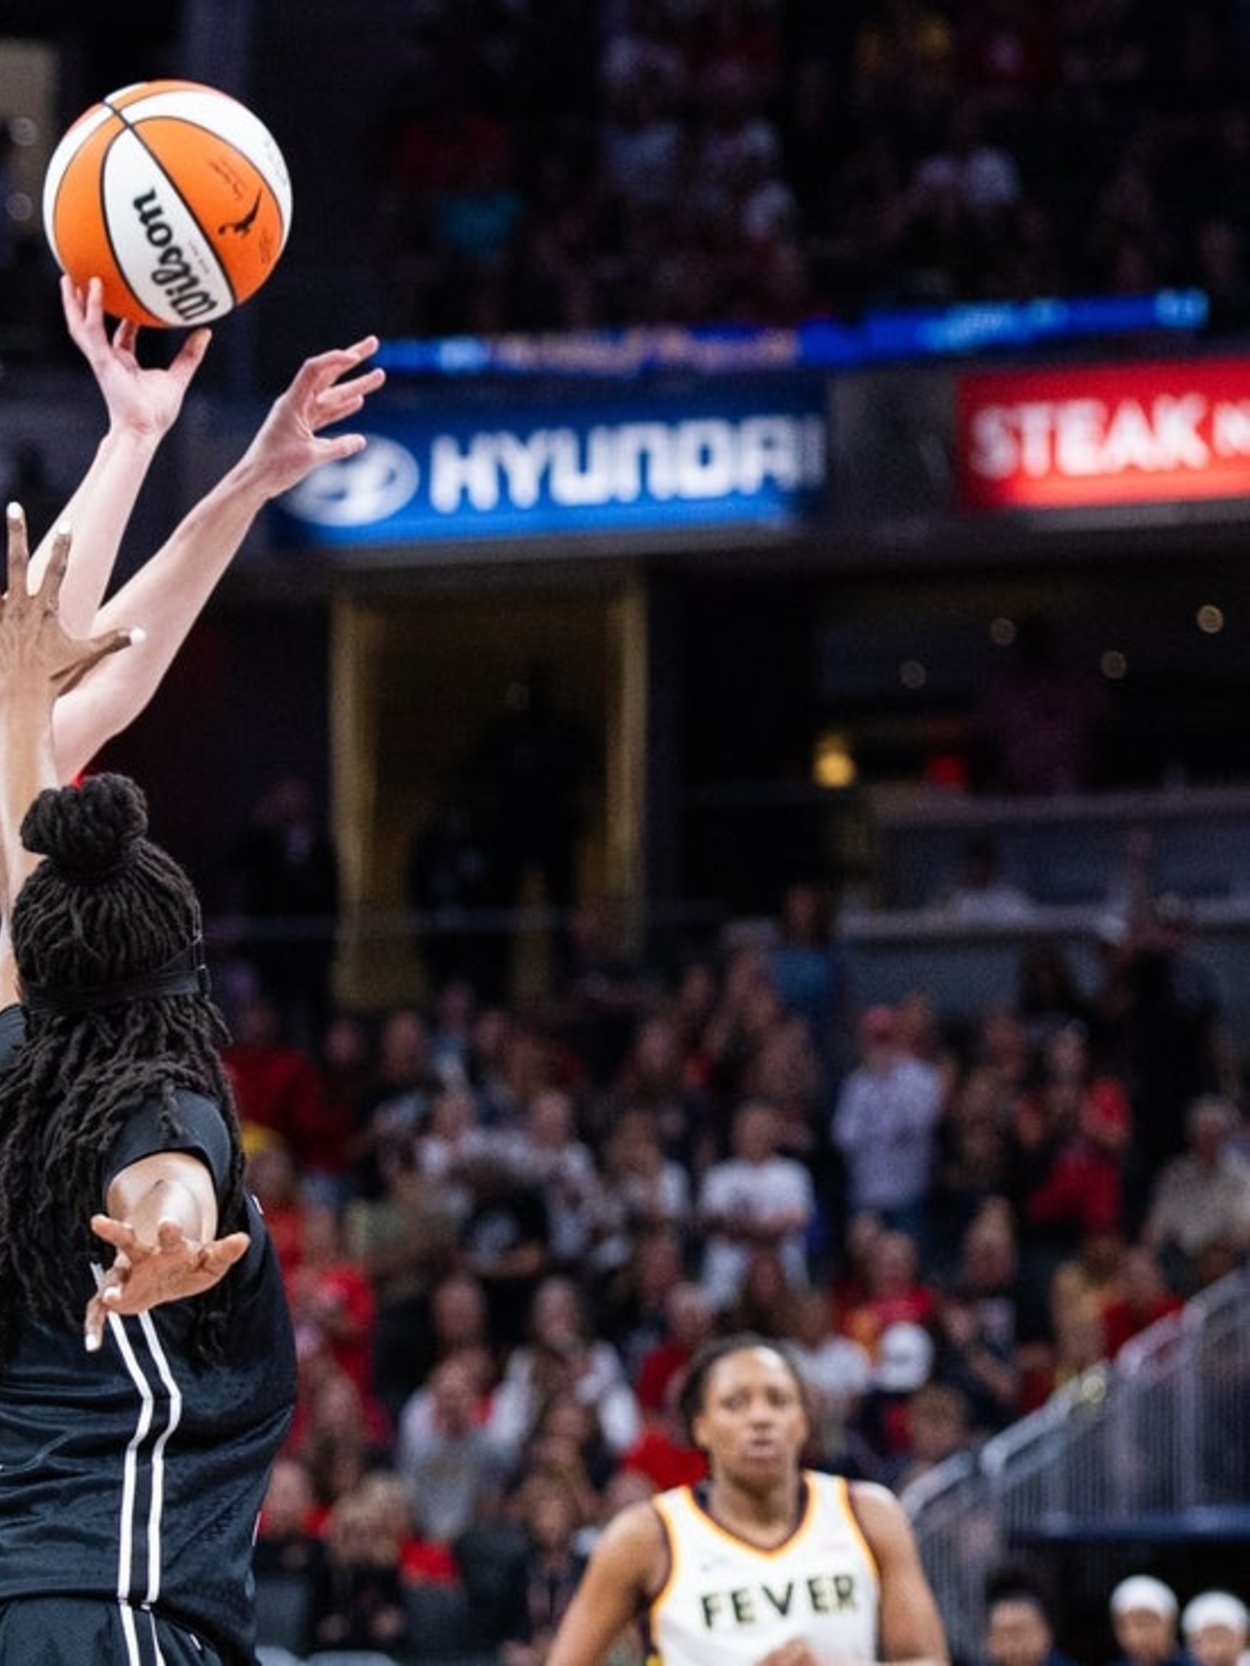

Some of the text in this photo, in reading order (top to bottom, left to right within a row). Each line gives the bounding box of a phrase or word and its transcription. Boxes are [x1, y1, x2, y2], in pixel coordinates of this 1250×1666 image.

[133, 187, 218, 323] Wilson
[430, 414, 827, 513] HYUNDAI
[971, 394, 1208, 477] STEAK
[700, 1574, 855, 1629] FEVER
